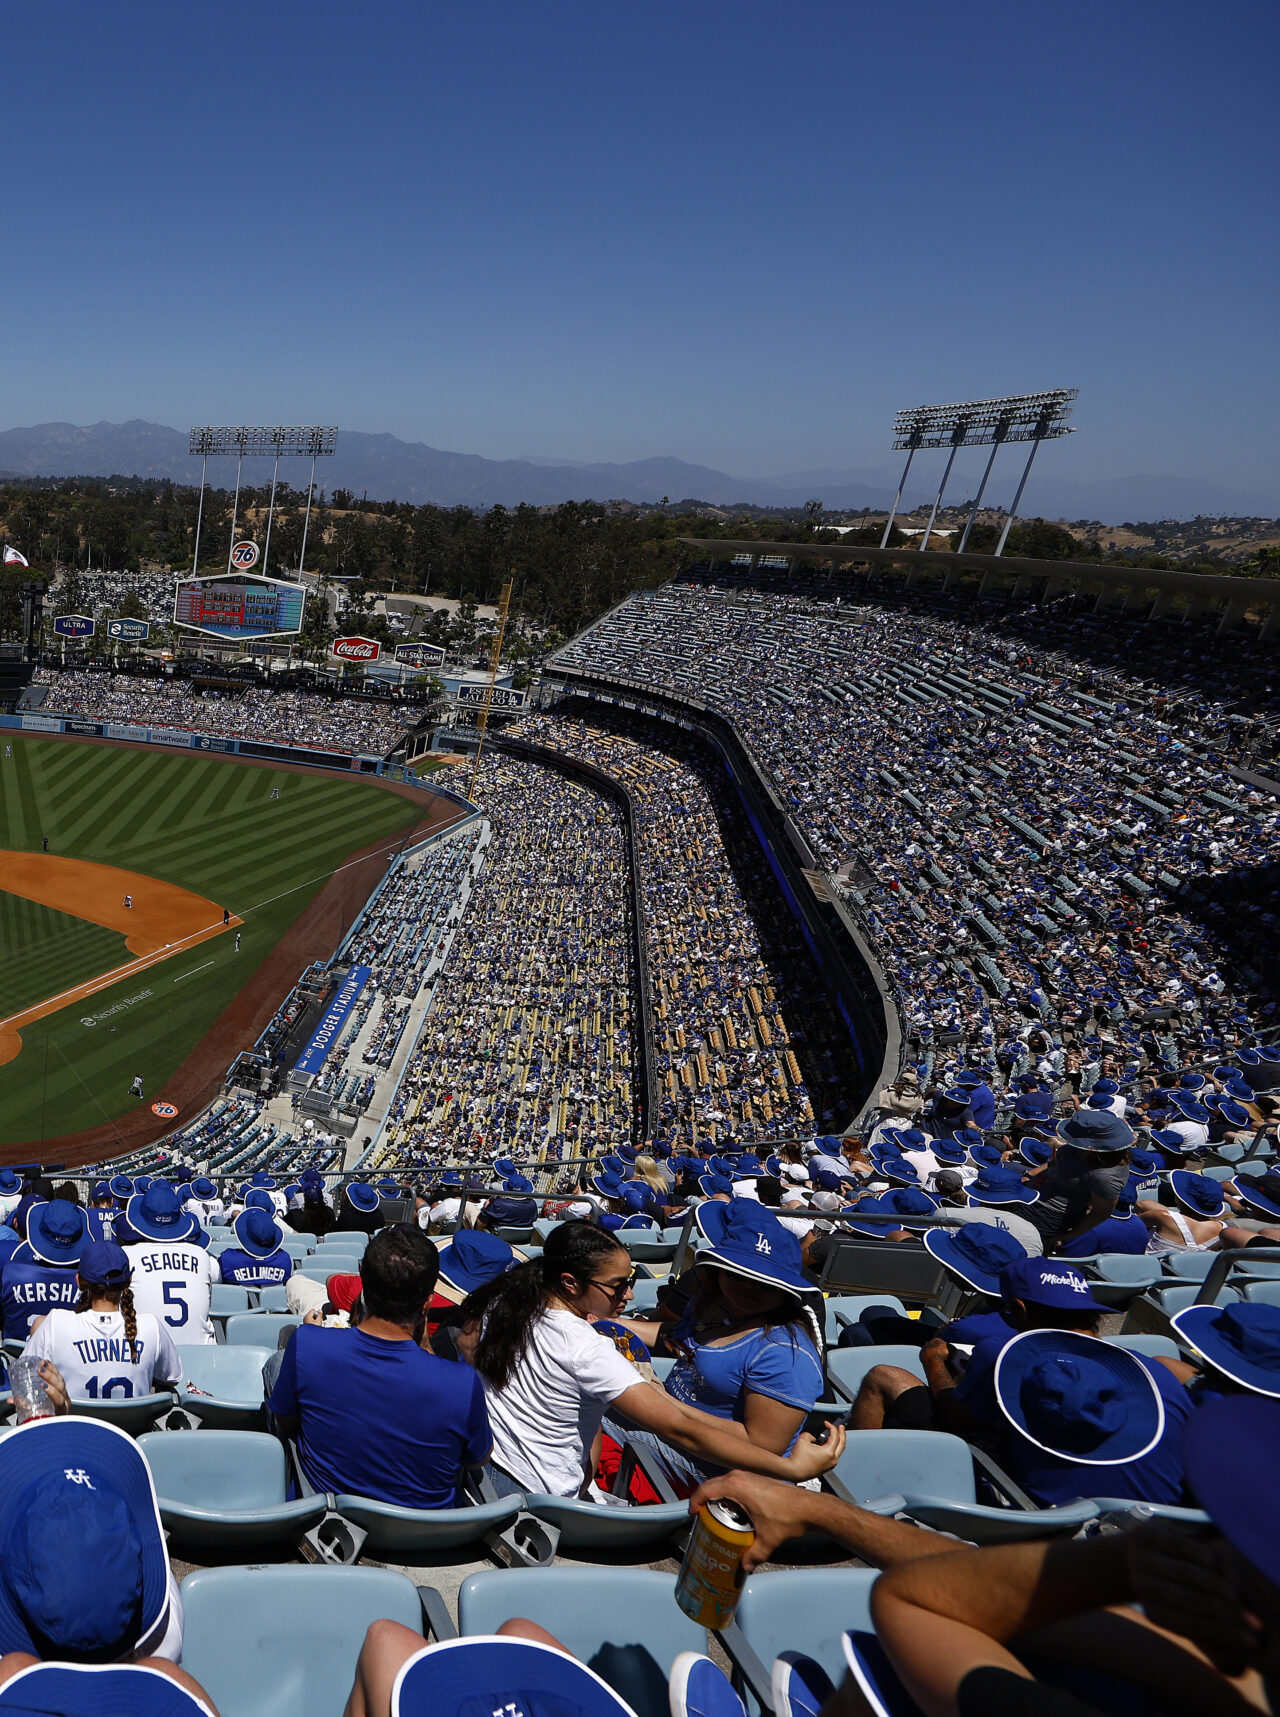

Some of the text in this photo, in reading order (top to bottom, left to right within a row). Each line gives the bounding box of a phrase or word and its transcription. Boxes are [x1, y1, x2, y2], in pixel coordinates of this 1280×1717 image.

[233, 547, 255, 563] 76
[62, 621, 86, 629] ULTRA
[122, 623, 145, 632] Security
[71, 723, 96, 731] Spectrum
[152, 733, 190, 744] smartwater
[93, 988, 154, 1020] Security Benefit
[312, 1014, 341, 1049] DODGER
[332, 980, 359, 1013] STADIUM
[155, 1105, 174, 1115] 76
[755, 1232, 772, 1255] LA
[141, 1252, 199, 1274] SEAGER
[233, 1266, 286, 1282] BELLINGER
[162, 1281, 189, 1327] 5
[72, 1338, 145, 1365] TURNER
[712, 1541, 739, 1560] ROAD
